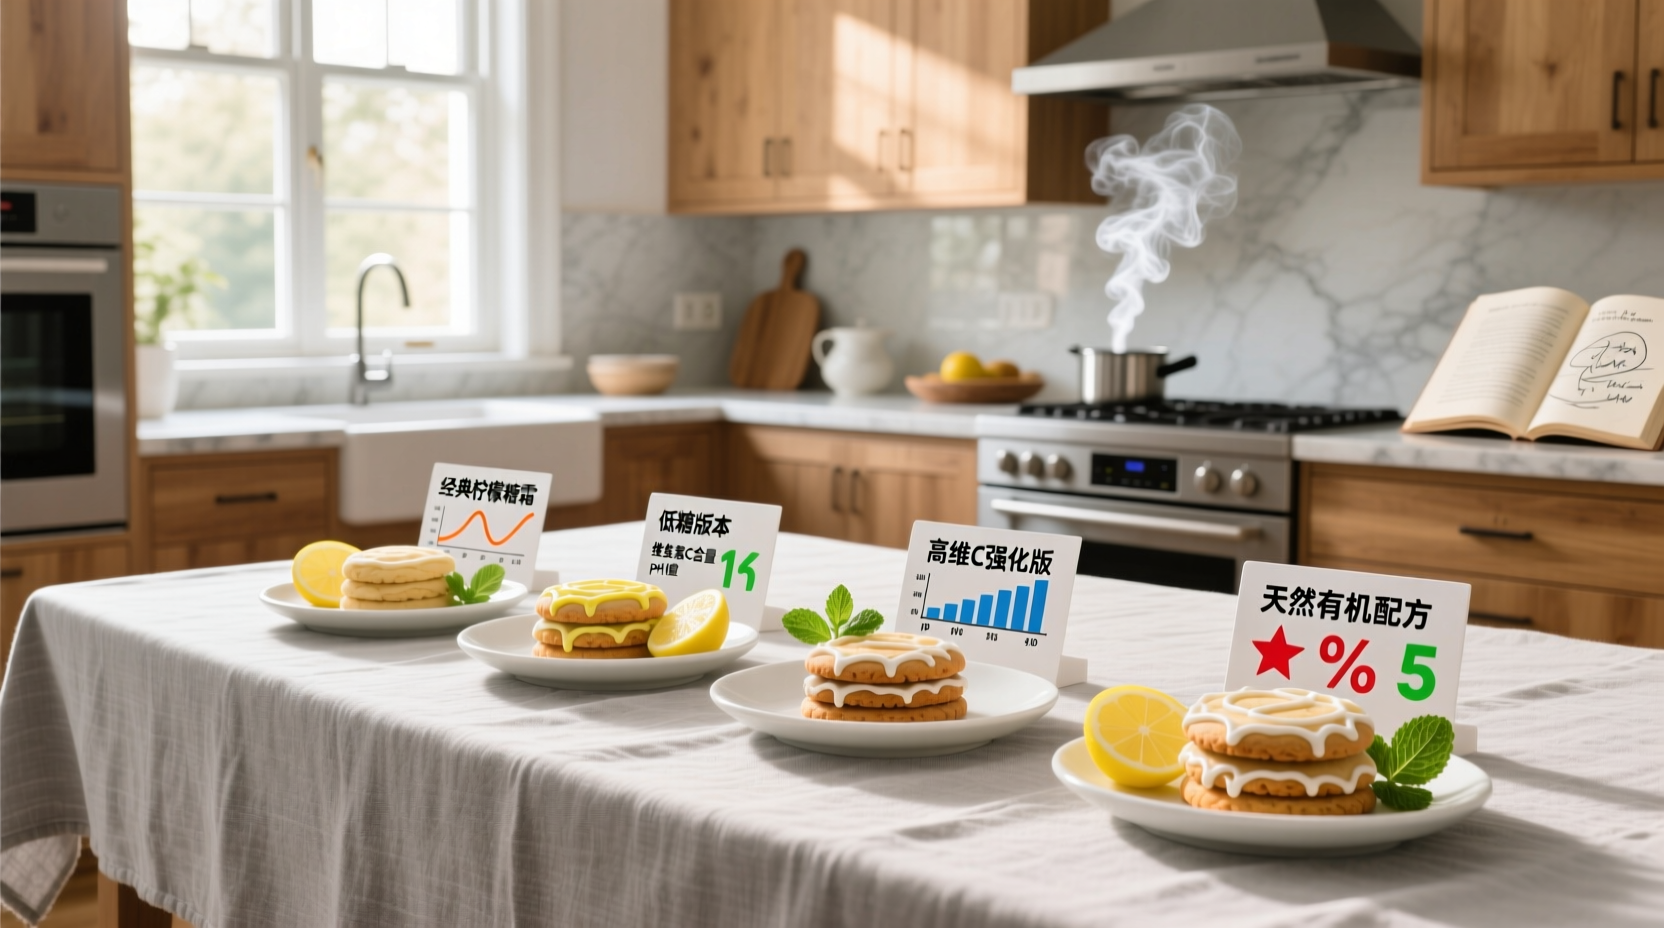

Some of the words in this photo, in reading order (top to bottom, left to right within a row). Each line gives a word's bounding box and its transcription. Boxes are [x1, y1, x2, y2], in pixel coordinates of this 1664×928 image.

[659, 510, 732, 538] 低糖版本
[927, 538, 1054, 575] 高维C强化版
[1261, 585, 1432, 630] 天然有机配方
[1319, 635, 1376, 694] %
[1397, 643, 1437, 701] 5
